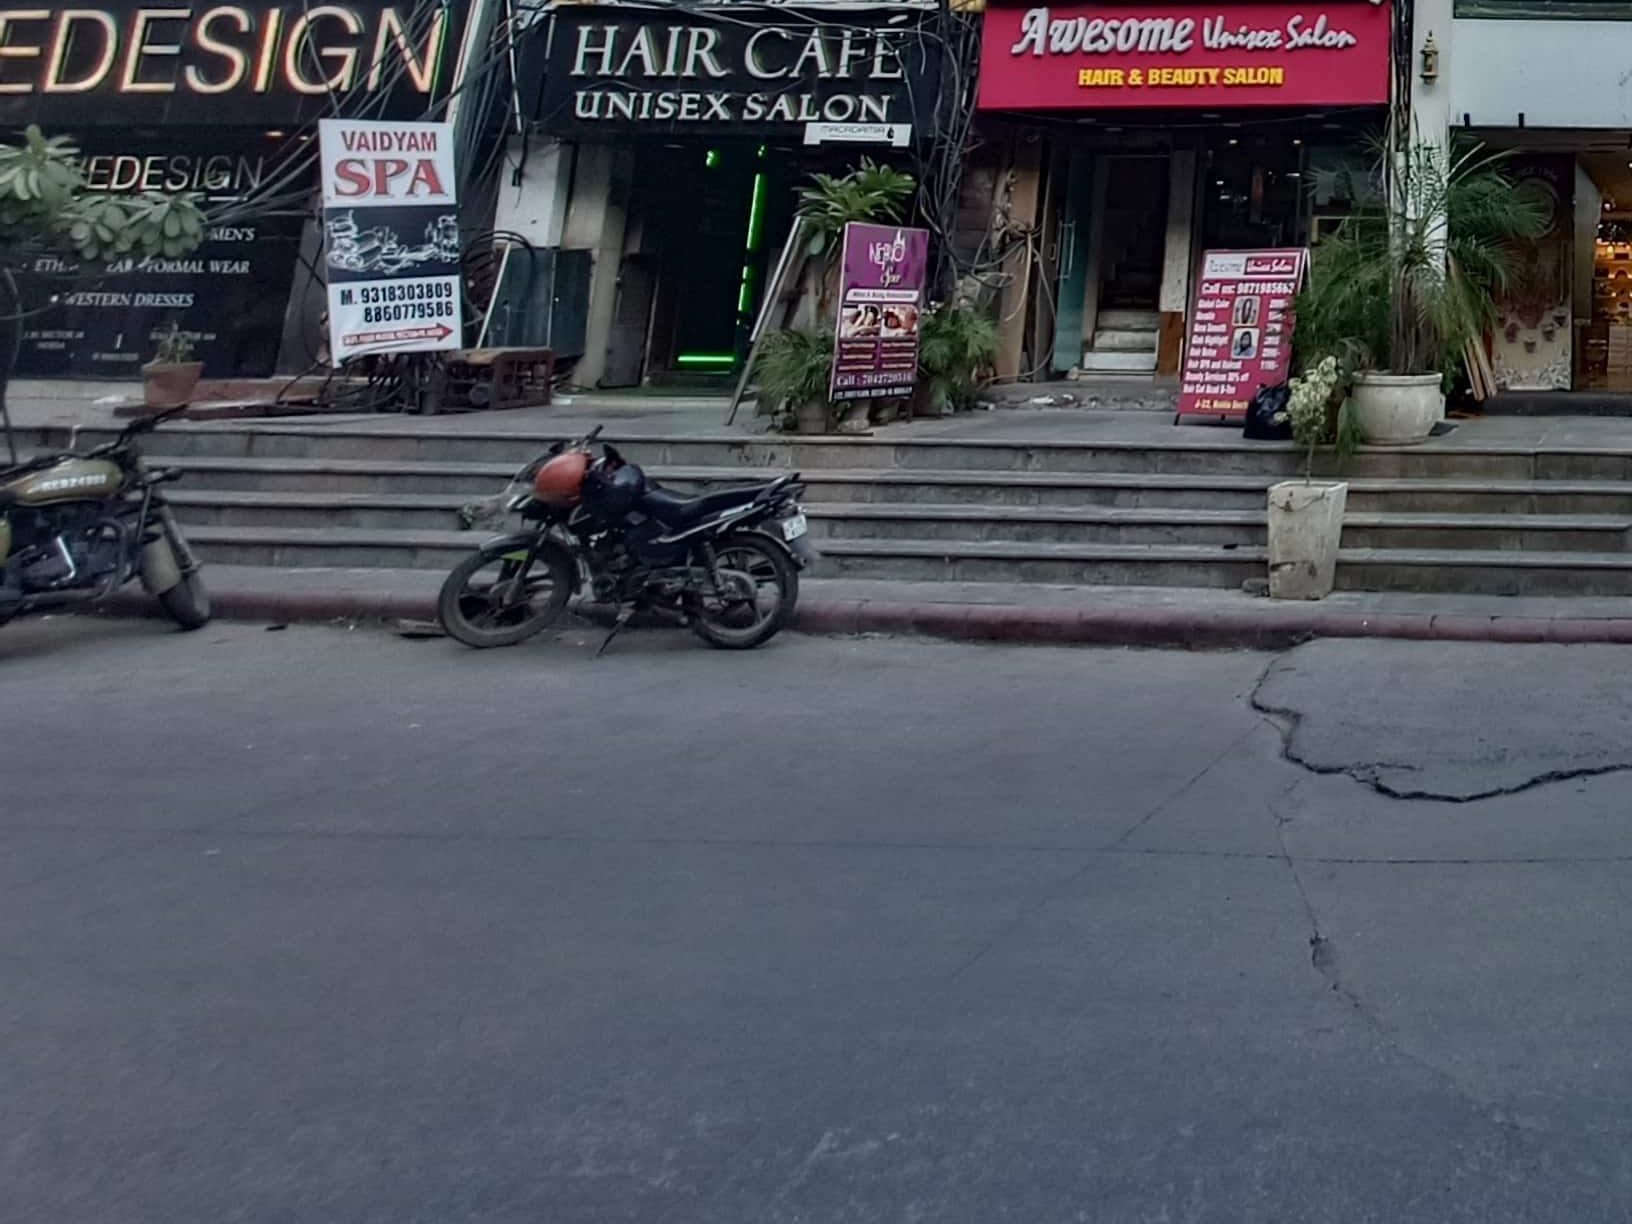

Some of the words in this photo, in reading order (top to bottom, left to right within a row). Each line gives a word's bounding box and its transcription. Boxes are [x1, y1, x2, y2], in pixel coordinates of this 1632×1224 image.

[1011, 6, 1195, 56] Awesome
[1203, 14, 1283, 50] Unisex
[1284, 13, 1358, 50] Salon
[570, 24, 733, 77] HAIR
[1078, 68, 1124, 87] HAIR
[1127, 68, 1143, 87] &
[1147, 67, 1220, 86] BEAUTY
[1222, 66, 1284, 86] SALON
[574, 91, 731, 121] UNISEX
[742, 93, 892, 122] SALON
[341, 130, 438, 152] VAIDYAM
[334, 158, 446, 197] SPA
[209, 260, 251, 274] WEAR
[134, 292, 195, 307] DRESSES
[340, 288, 358, 306] M.
[360, 281, 453, 305] 9318303809
[363, 300, 454, 323] 8860779586
